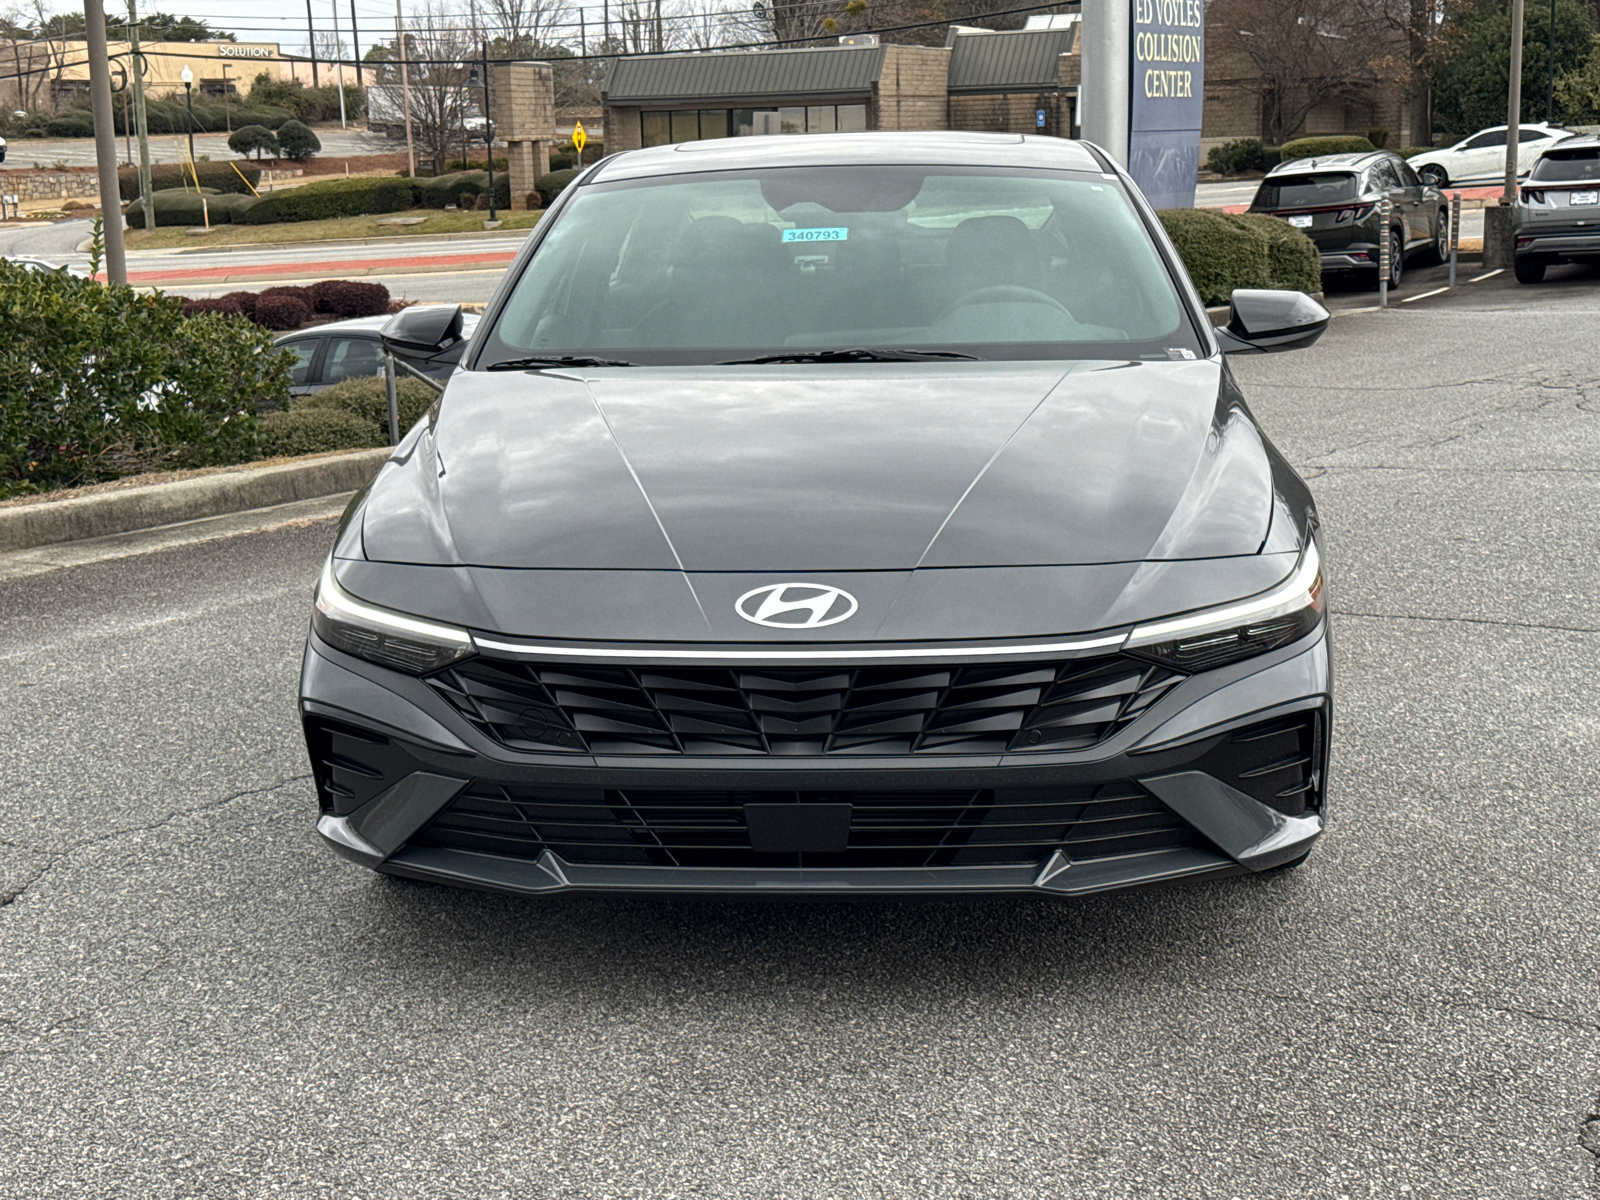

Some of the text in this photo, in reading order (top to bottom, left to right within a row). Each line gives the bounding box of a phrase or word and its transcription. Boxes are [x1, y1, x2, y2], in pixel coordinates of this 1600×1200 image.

[1136, 0, 1201, 28] ED VOYLES
[1136, 32, 1201, 63] COLLISION
[1145, 69, 1192, 98] CENTER
[788, 230, 840, 241] 340793
